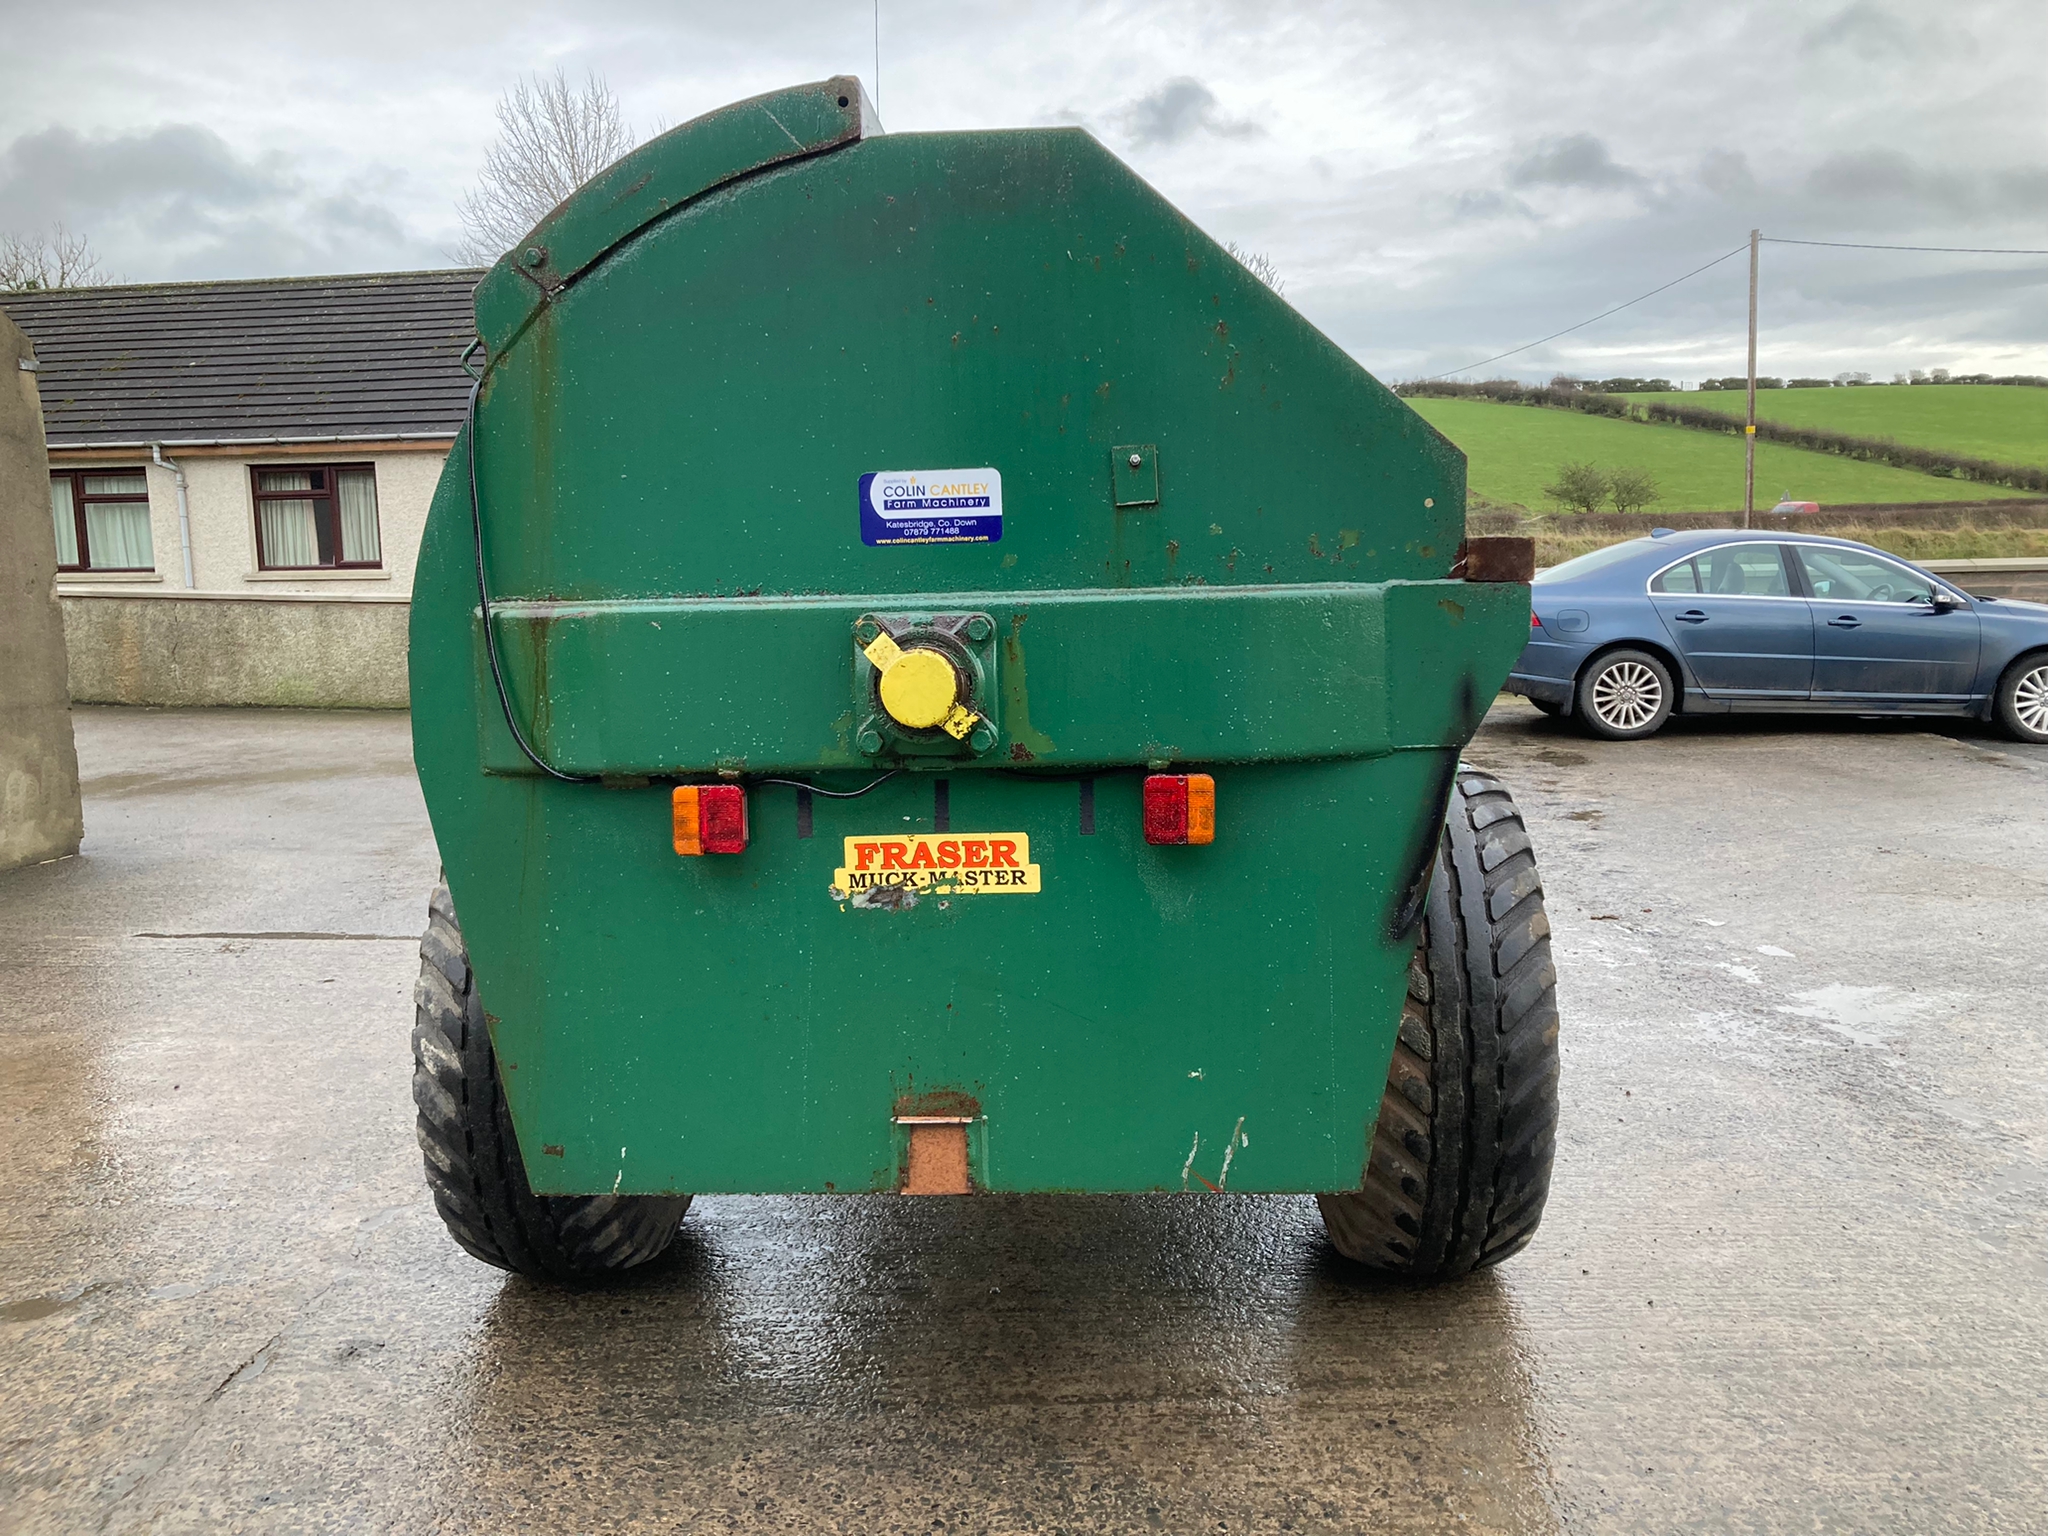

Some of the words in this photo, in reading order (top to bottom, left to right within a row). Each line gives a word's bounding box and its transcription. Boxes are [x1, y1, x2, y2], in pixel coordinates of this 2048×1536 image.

[884, 485, 925, 497] COLIN
[930, 483, 988, 495] CANTLEY
[887, 501, 917, 509] Farm
[922, 497, 986, 508] Machinery
[937, 519, 952, 528] Co.
[954, 519, 977, 527] Down
[904, 528, 928, 536] 07879
[930, 527, 960, 535] 771488
[854, 840, 1019, 870] FRASER
